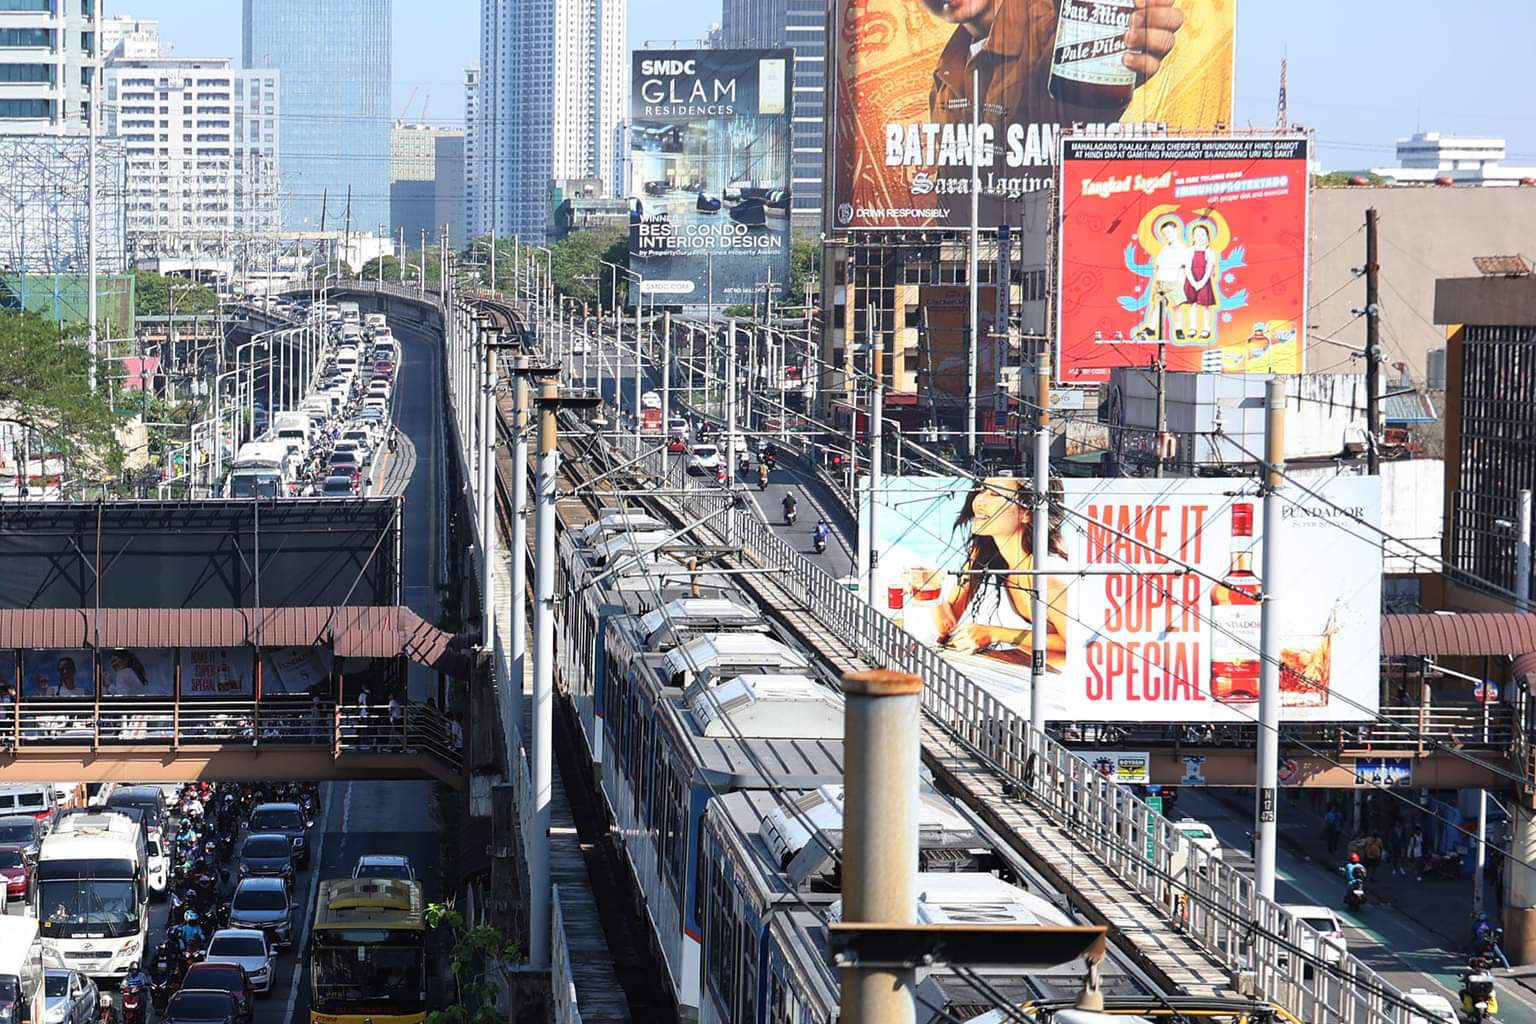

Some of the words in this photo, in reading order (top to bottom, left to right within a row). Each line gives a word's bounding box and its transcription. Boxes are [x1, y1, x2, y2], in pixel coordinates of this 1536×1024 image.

[1061, 45, 1090, 62] Pale
[641, 60, 696, 75] SMDC
[641, 78, 736, 103] GLAM
[645, 105, 734, 116] RESIDENCES
[884, 122, 995, 168] BATANG
[1006, 122, 1061, 167] SAN
[1150, 142, 1165, 151] ANG
[1274, 141, 1299, 150] GAMOT
[1074, 151, 1083, 159] AT
[1084, 151, 1103, 159] HINDI
[1081, 175, 1132, 198] Tangkad
[856, 208, 885, 218] DRINK
[886, 207, 950, 218] RESPONSIBLY
[639, 224, 679, 236] BEST
[686, 224, 748, 236] CONDO
[639, 236, 715, 248] INTERIOR
[719, 235, 782, 248] DESIGN
[1282, 504, 1364, 518] FUNDADOR
[1086, 505, 1170, 564] MAKE
[1180, 505, 1209, 565] IT
[1104, 573, 1201, 633] SUPER
[1085, 641, 1206, 701] SPECIAL
[1263, 790, 1272, 798] N
